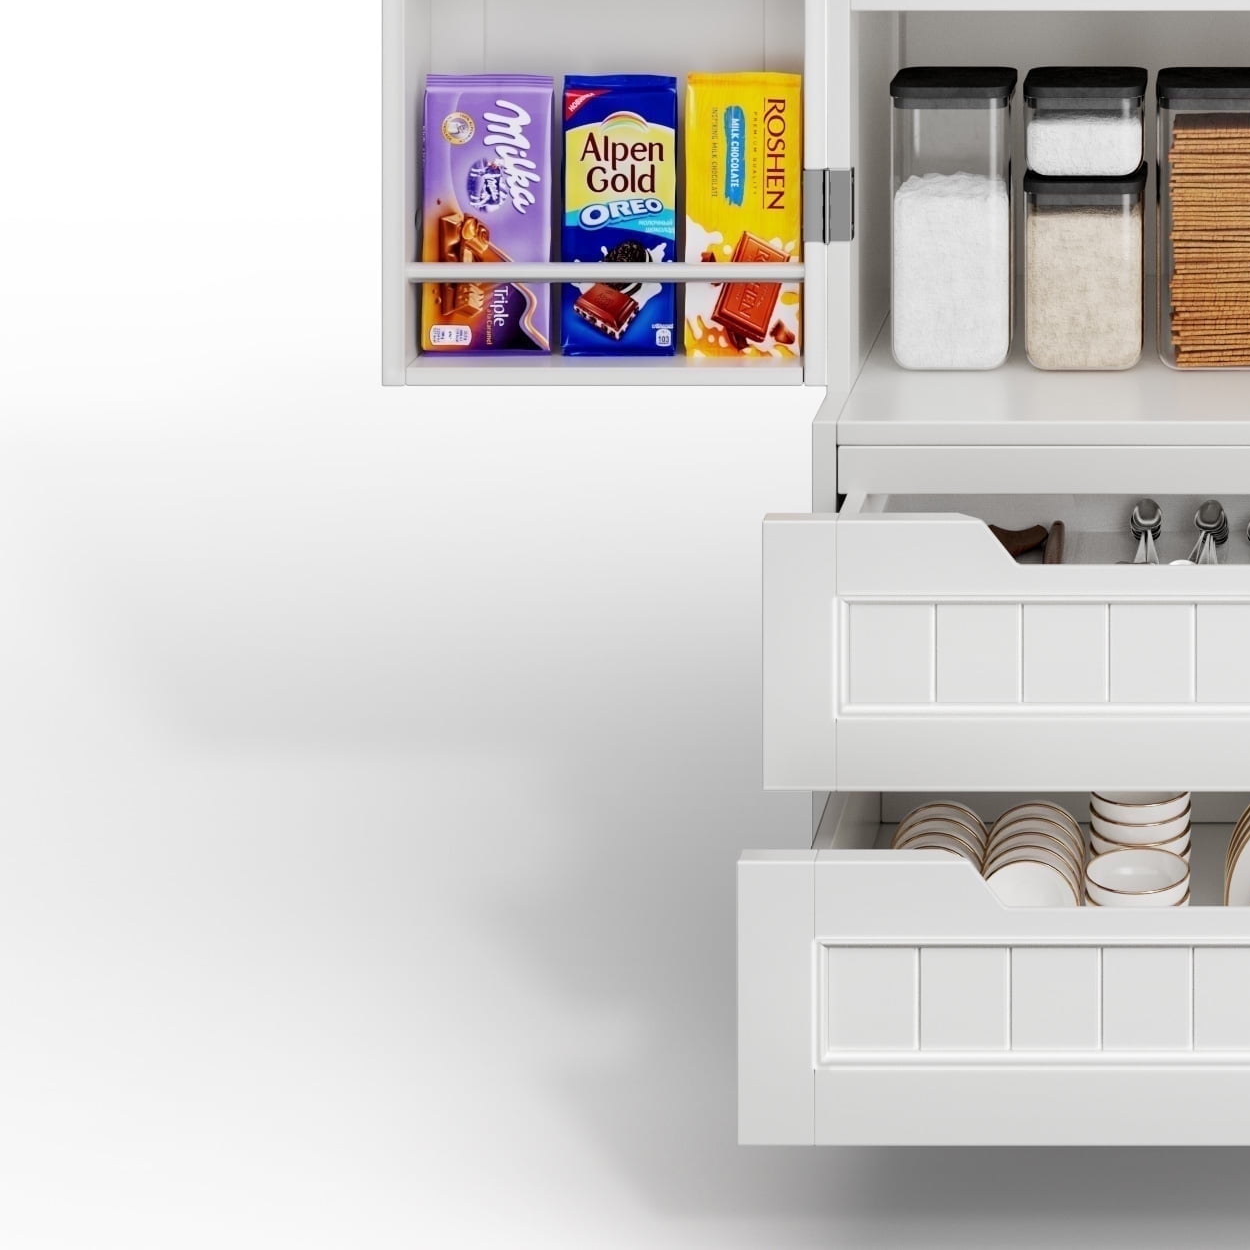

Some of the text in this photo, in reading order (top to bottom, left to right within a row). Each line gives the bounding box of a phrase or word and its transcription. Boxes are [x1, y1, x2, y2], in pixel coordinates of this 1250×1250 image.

[483, 99, 541, 214] Milka
[580, 131, 664, 171] Alpen
[711, 107, 719, 198] INSPIRING MILK CHOCOLATE
[730, 118, 740, 188] MILK CHOCOLATE
[766, 98, 786, 210] ROSHEN
[586, 164, 656, 193] Gold
[580, 198, 664, 227] OREO
[490, 285, 509, 327] Triple
[658, 335, 670, 343] 103
